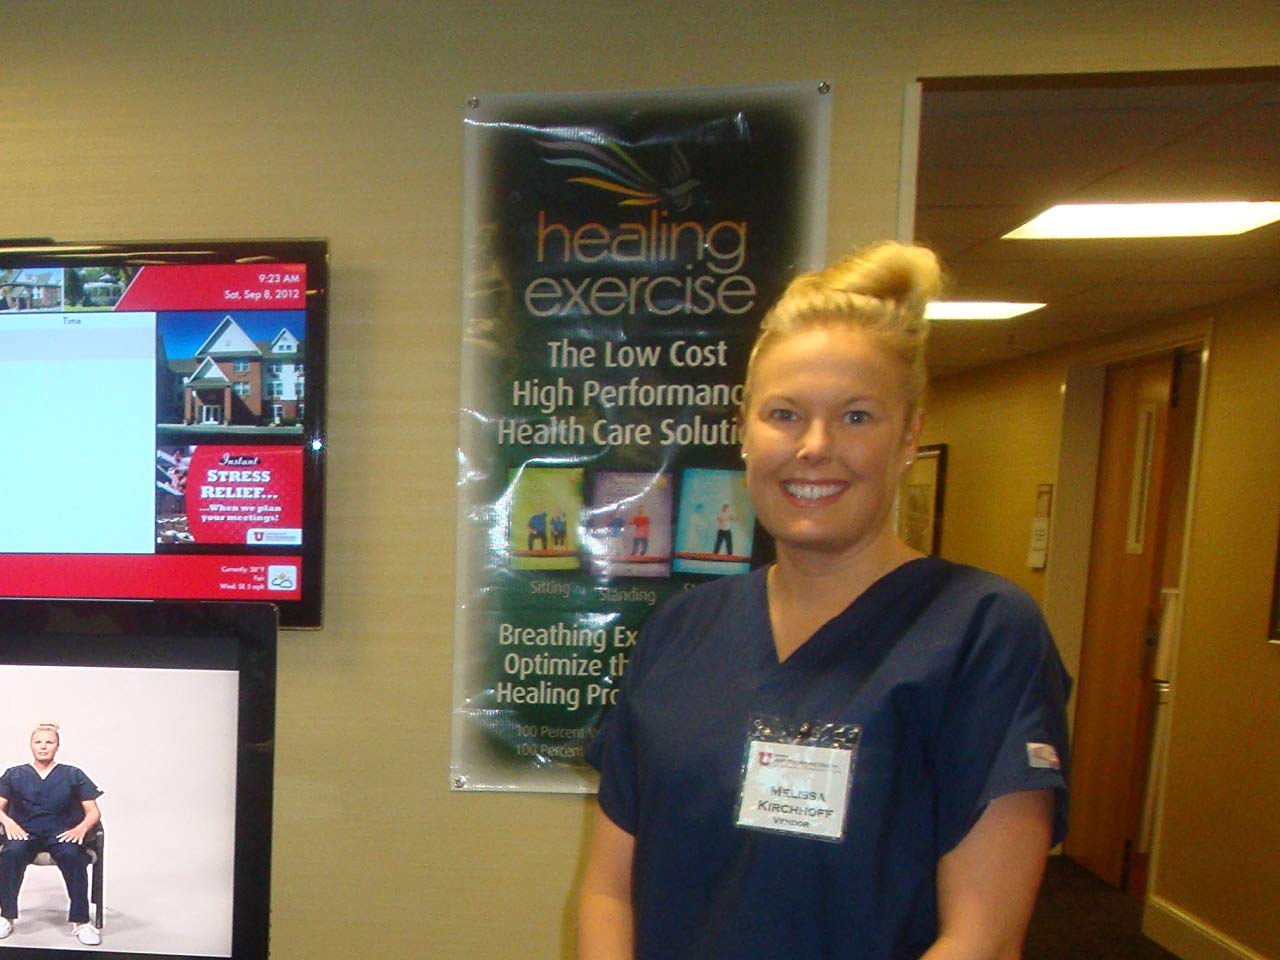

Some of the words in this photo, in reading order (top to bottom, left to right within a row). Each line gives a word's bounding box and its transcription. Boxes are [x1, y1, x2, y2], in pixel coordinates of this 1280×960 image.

[536, 208, 749, 275] healing
[258, 273, 280, 283] 9:23
[282, 274, 300, 283] AM
[224, 289, 242, 300] Sat,
[244, 289, 262, 301] Sep
[275, 288, 300, 299] 2012
[524, 263, 757, 317] exercise
[63, 316, 82, 326] Time
[547, 338, 596, 369] The
[604, 341, 661, 368] Low
[670, 340, 728, 368] Cost
[512, 377, 575, 413] High
[498, 418, 585, 446] Health
[592, 419, 652, 446] Care
[660, 415, 745, 446] Soluti
[219, 452, 259, 466] Instant
[207, 469, 272, 483] STRESS
[200, 485, 279, 499] RELIEF...
[257, 504, 282, 514] plan
[201, 515, 226, 523] your
[530, 579, 573, 599] Sitting
[598, 587, 657, 606] Standing
[498, 622, 607, 653] Breathing
[504, 652, 603, 680] Optimize
[496, 681, 580, 711] Healing
[540, 725, 585, 739] Percent
[757, 799, 834, 819] KIRCHHOFF
